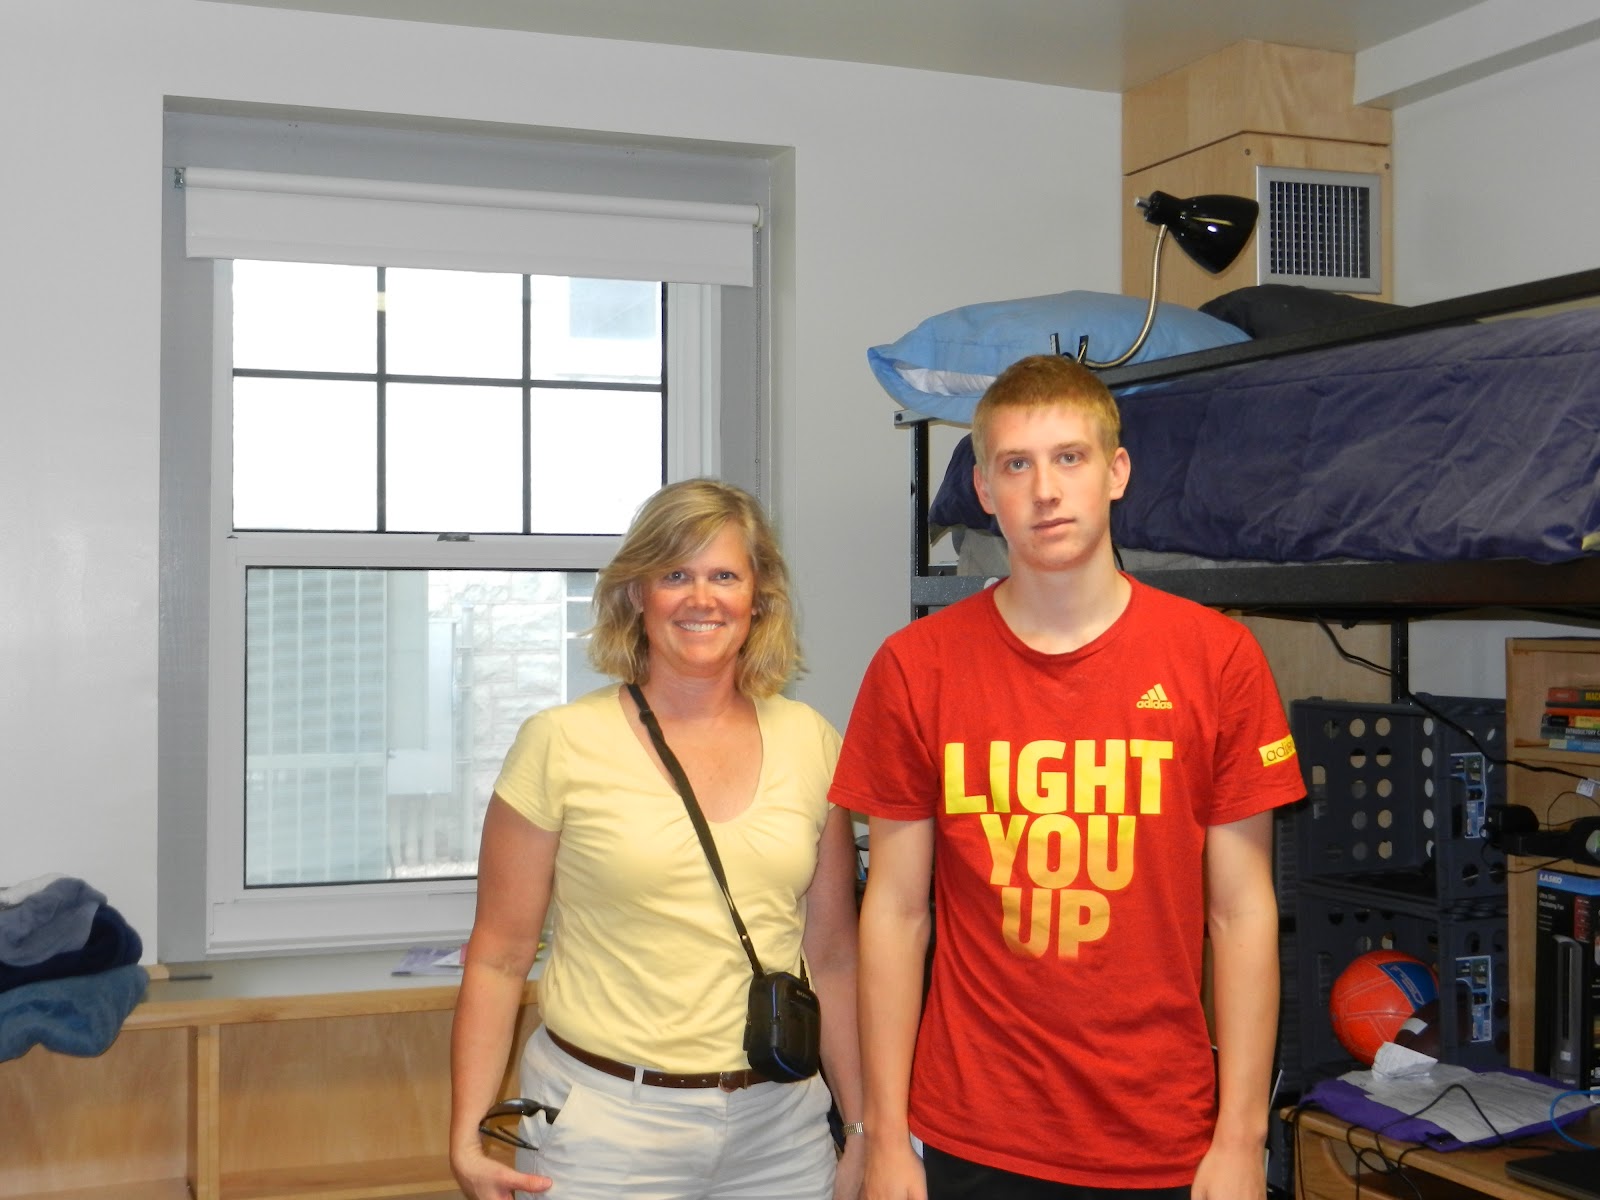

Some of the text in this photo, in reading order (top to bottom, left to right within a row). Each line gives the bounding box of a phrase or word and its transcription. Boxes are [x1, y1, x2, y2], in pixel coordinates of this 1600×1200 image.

[1136, 699, 1173, 710] adidas
[944, 739, 1174, 815] LIGHT
[980, 813, 1137, 891] YOU
[1539, 873, 1562, 884] LASKO
[1001, 886, 1111, 961] UP
